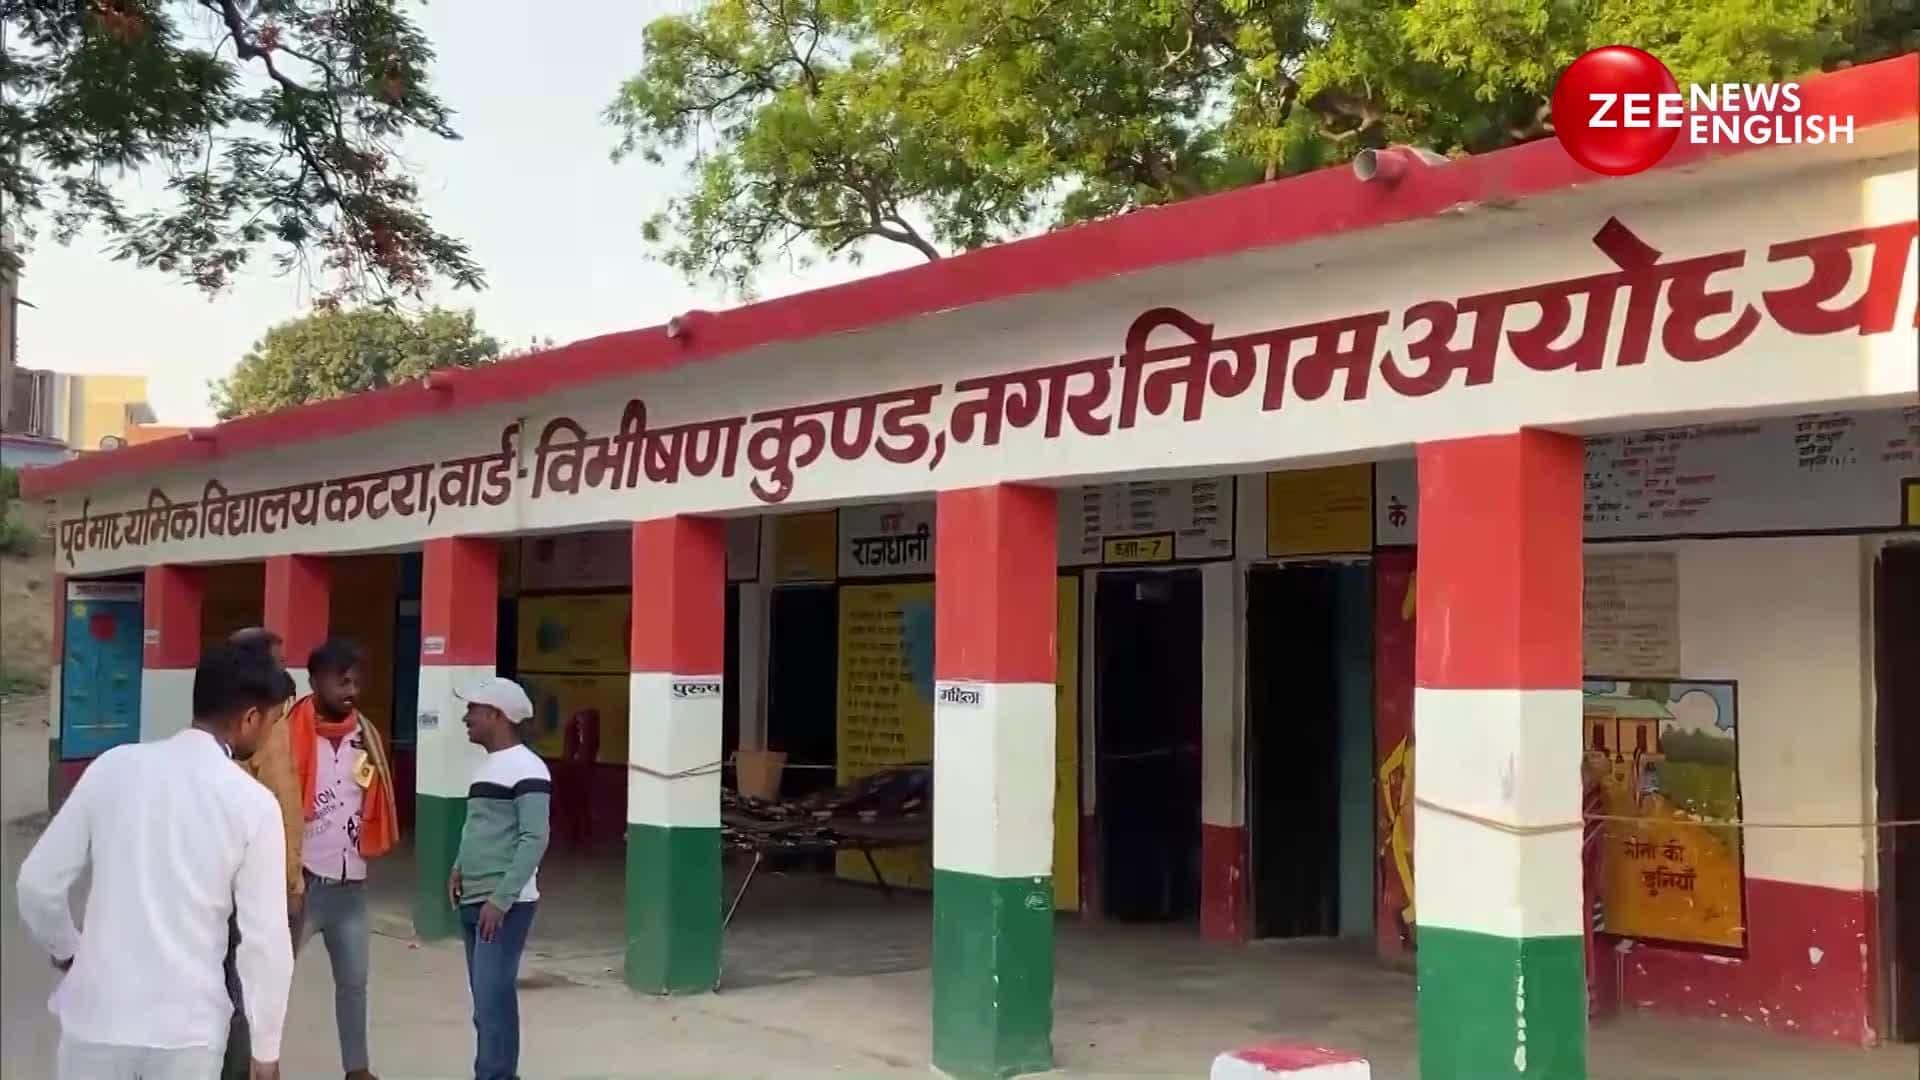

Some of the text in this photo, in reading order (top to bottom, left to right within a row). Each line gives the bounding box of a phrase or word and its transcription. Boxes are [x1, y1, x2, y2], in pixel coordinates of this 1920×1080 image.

[200, 479, 323, 539] विद्यालय
[950, 355, 1115, 447] नगर
[1118, 307, 1390, 430] निगम
[1380, 215, 1920, 397] अयोध्य
[852, 522, 931, 566] राजधानी
